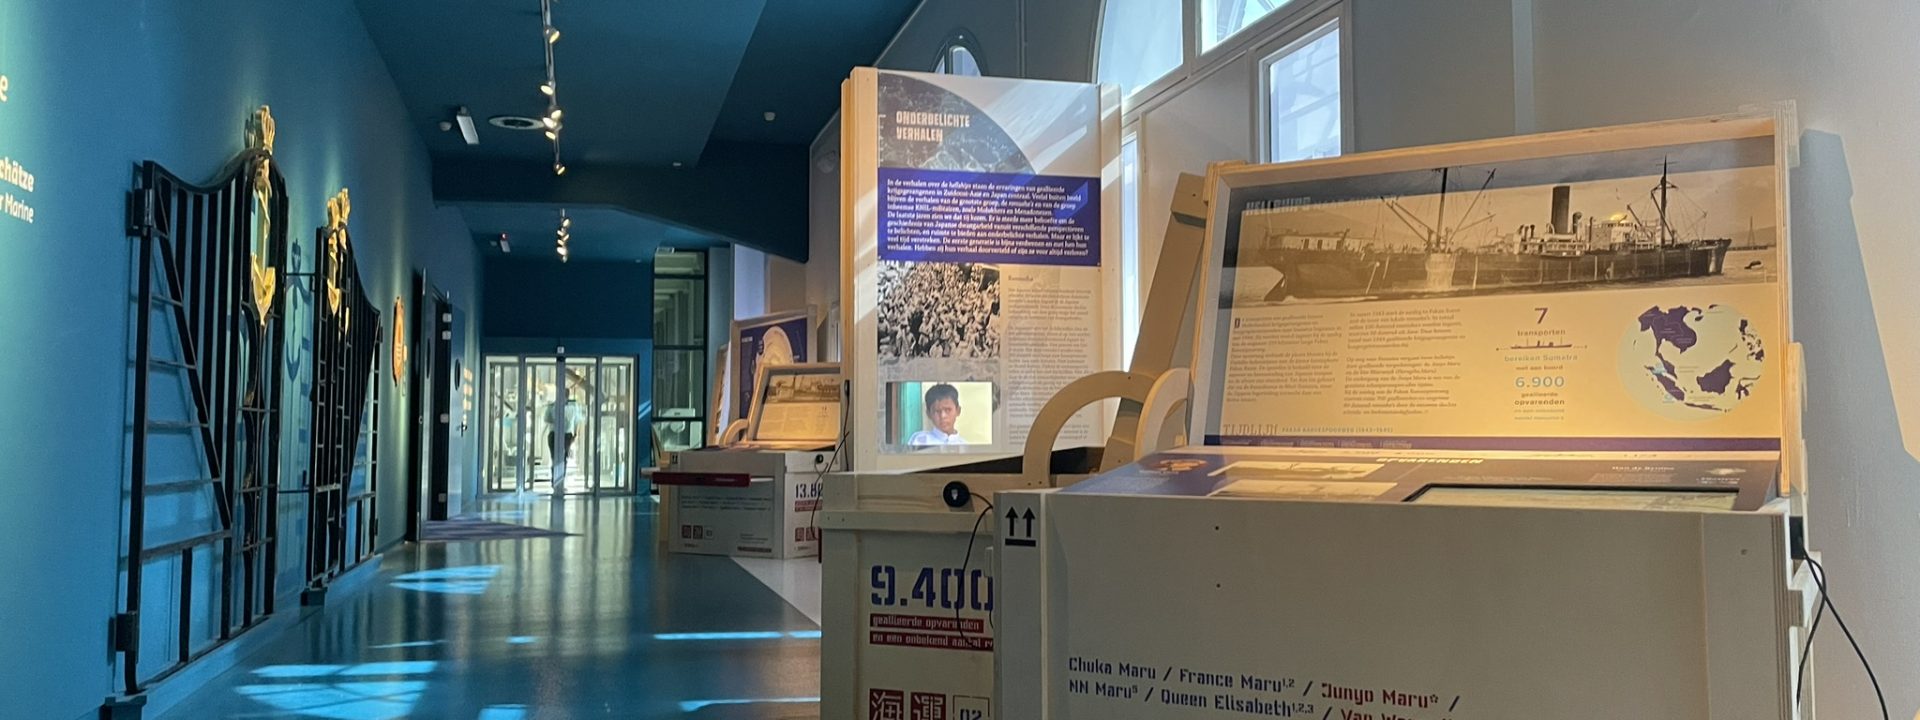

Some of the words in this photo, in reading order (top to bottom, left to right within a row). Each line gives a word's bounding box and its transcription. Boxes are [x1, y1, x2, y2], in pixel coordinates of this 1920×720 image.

[896, 110, 970, 128] ONDERBELICHTE
[896, 126, 943, 142] VERHALEN
[5, 192, 34, 223] Marine
[1534, 307, 1548, 324] 7
[1517, 329, 1566, 337] transporten
[1515, 376, 1565, 388] 6.900
[871, 565, 993, 611] 9.400
[873, 615, 922, 628] geallieerde
[873, 633, 884, 643] en
[887, 635, 903, 643] een
[906, 636, 949, 646] onbekend
[1069, 657, 1112, 675] Chuka
[1119, 663, 1156, 680] Maru
[1180, 668, 1233, 688] France
[1322, 683, 1374, 706] Junyo
[1069, 679, 1088, 694] NN
[1161, 689, 1207, 708] Queen
